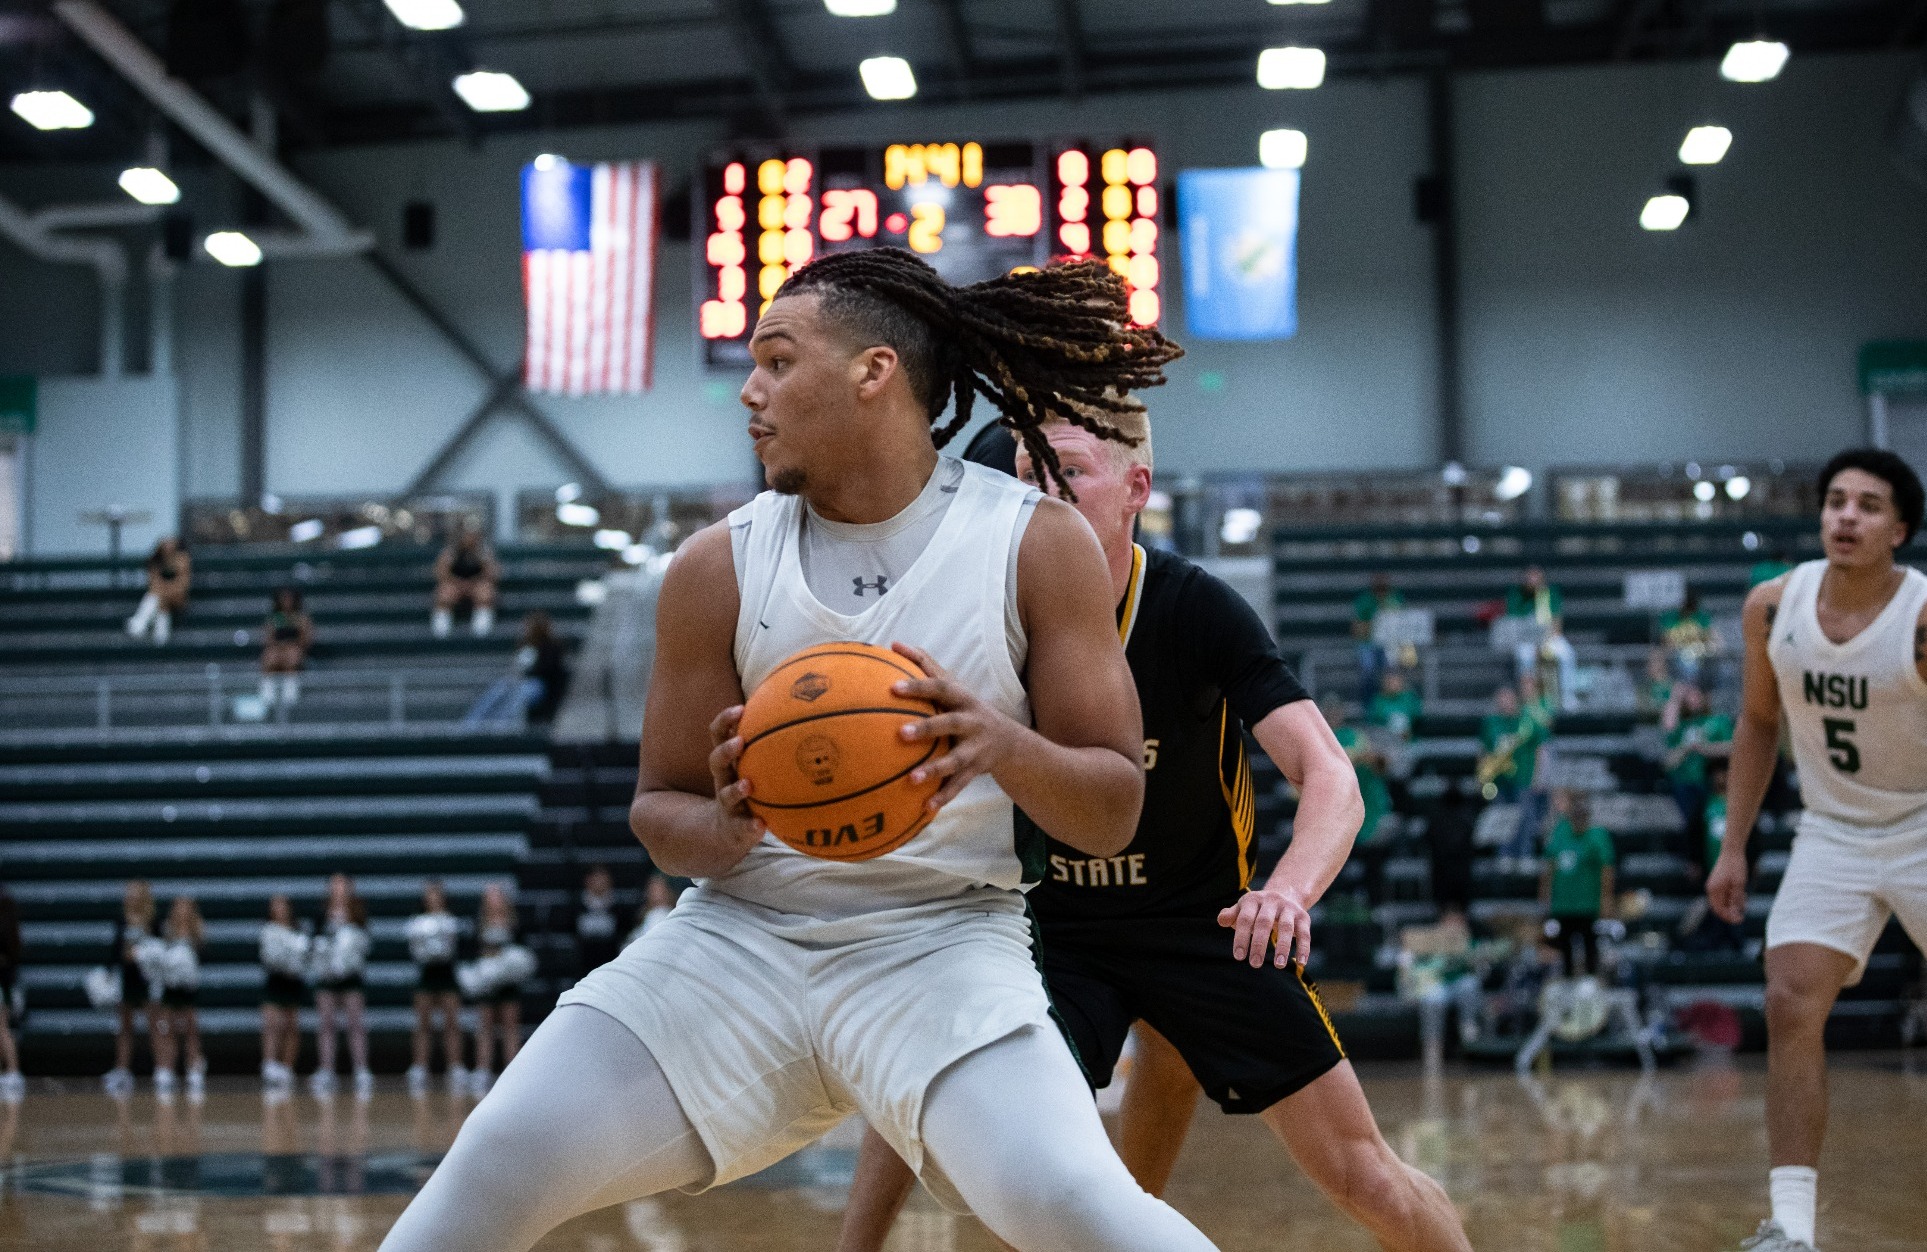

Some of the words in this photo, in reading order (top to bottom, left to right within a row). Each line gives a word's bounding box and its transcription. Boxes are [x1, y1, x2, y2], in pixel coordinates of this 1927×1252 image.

[820, 189, 878, 241] 27
[909, 204, 945, 253] 2
[1803, 669, 1868, 711] NSU
[1823, 715, 1861, 774] 5
[806, 812, 884, 846] EVO
[1050, 853, 1148, 888] STATE
